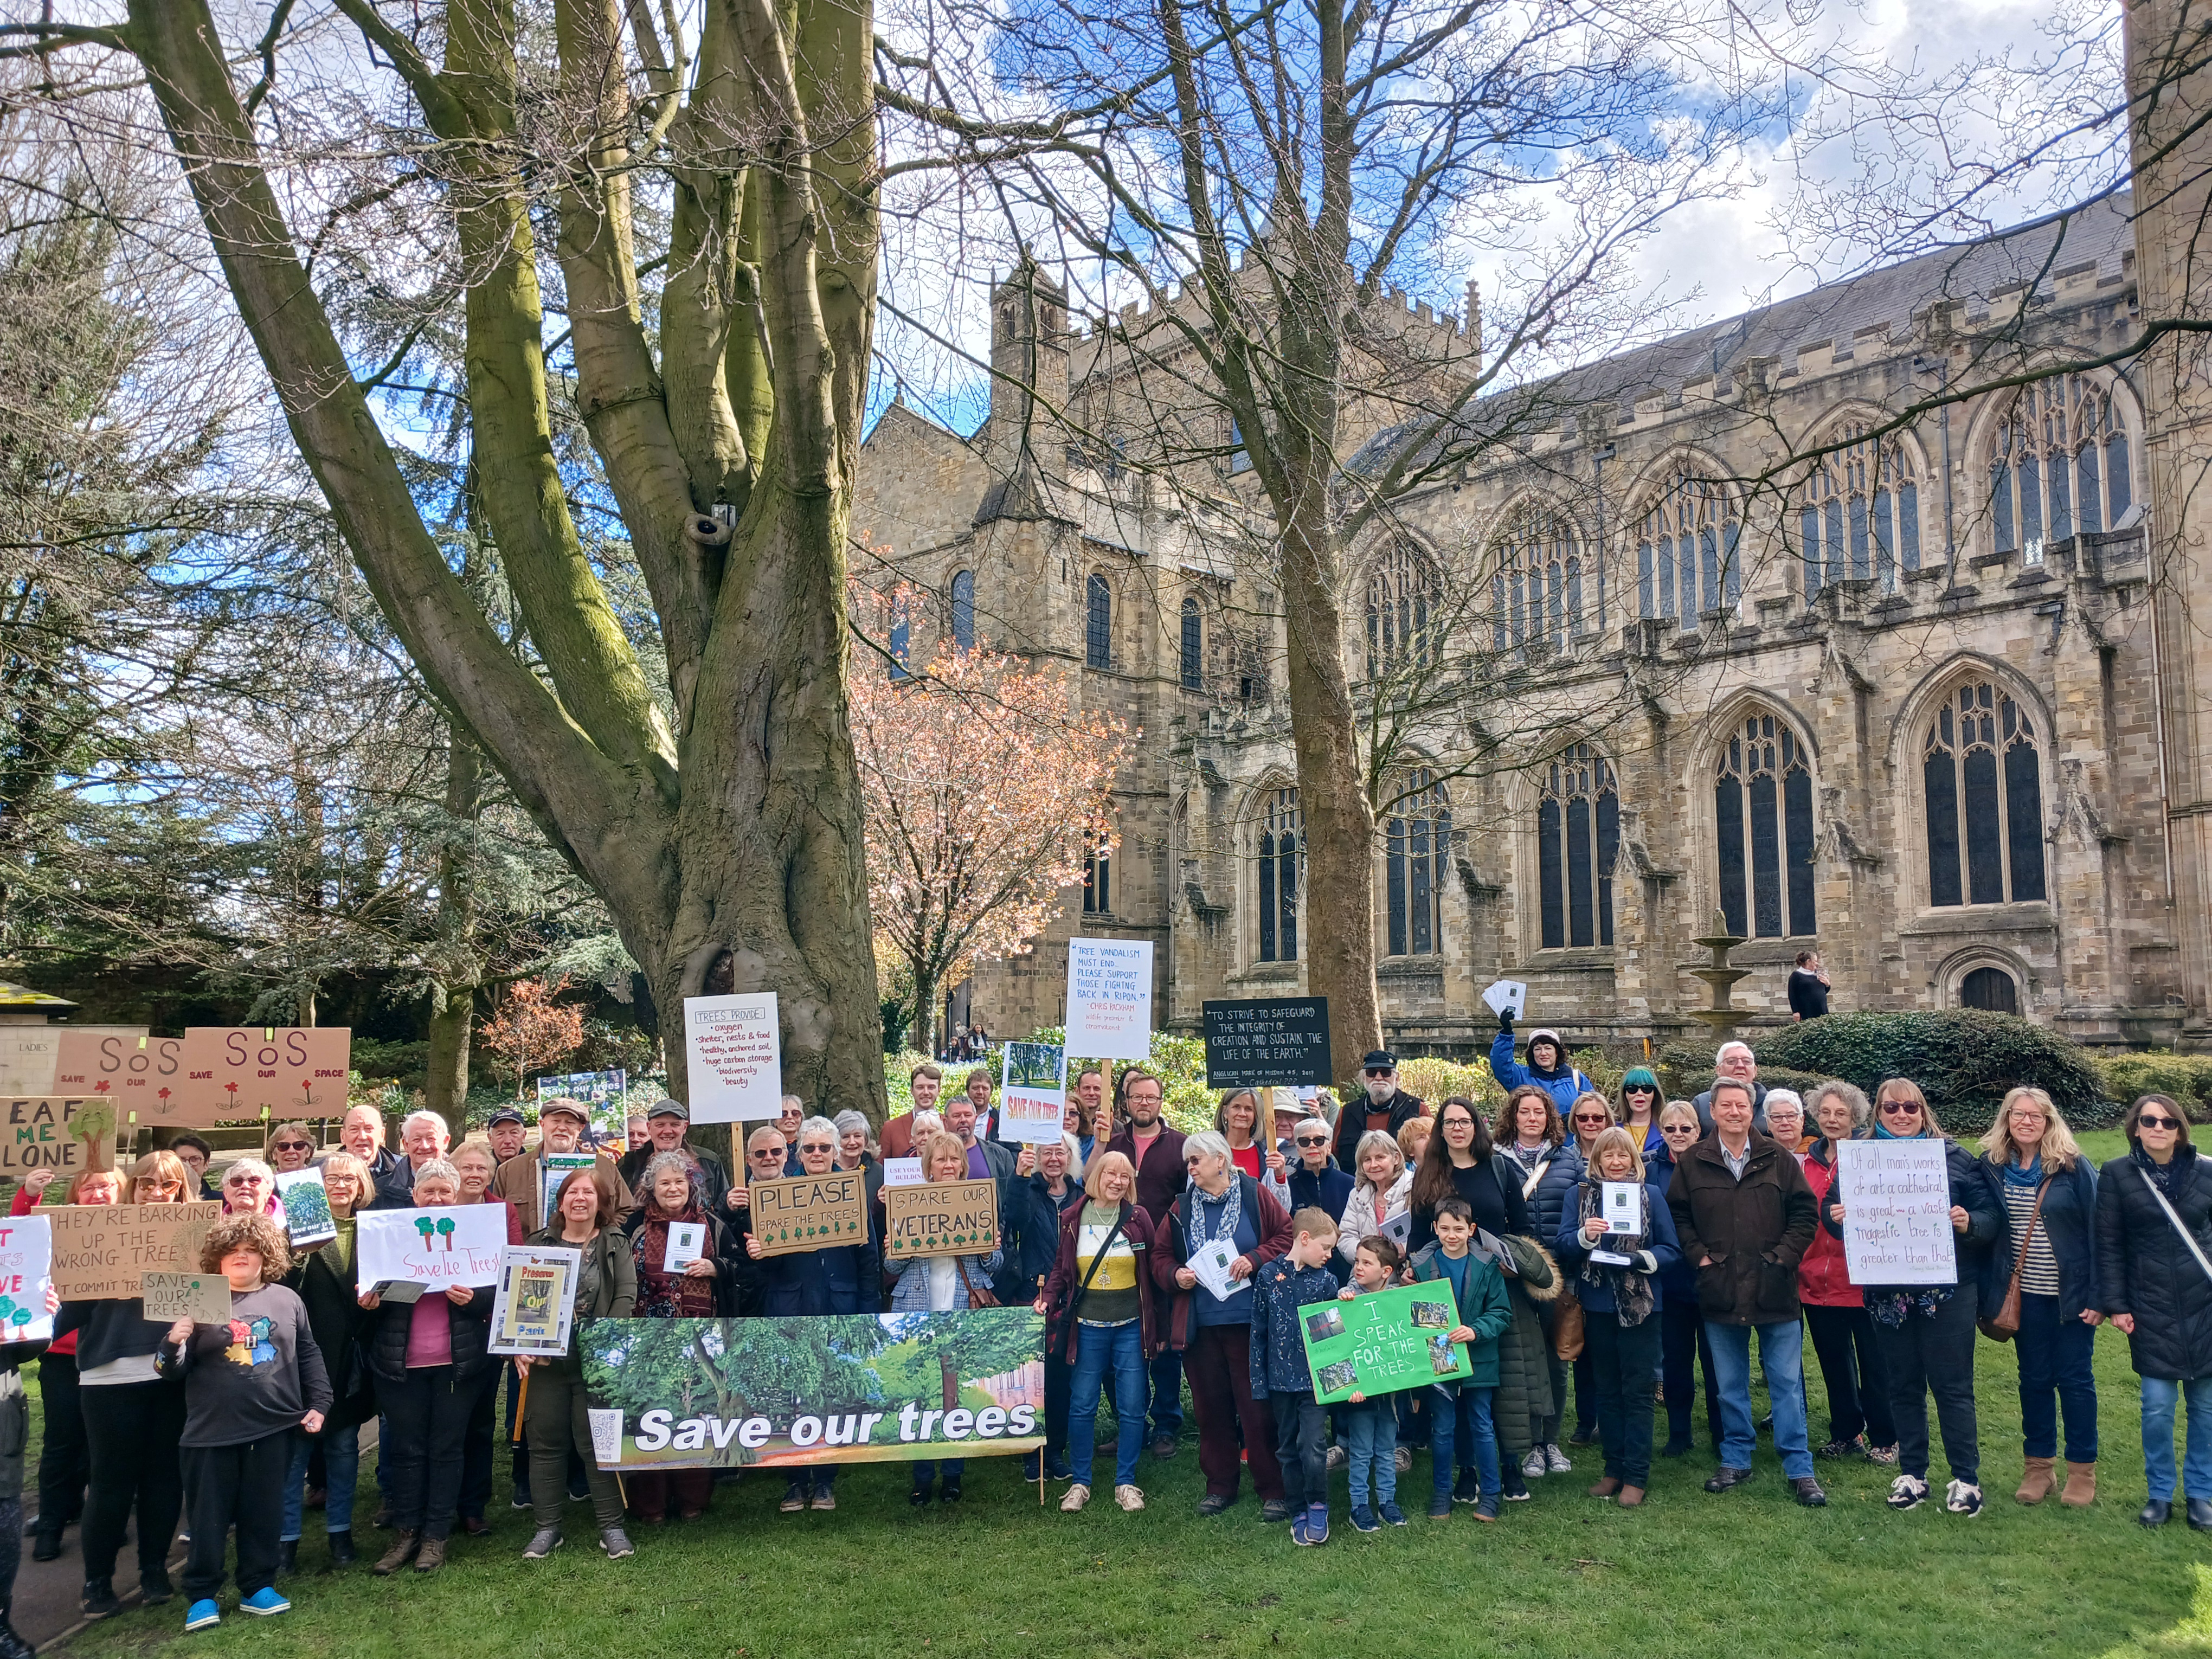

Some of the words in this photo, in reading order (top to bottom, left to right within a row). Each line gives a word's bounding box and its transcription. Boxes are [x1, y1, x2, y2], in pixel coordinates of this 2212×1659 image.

[1099, 948, 1140, 958] VANDALISM
[1078, 958, 1097, 966] MUST
[1077, 968, 1103, 978] PLEASE
[1107, 970, 1138, 979] SUPPORT
[1076, 979, 1099, 988] THOSE
[1077, 989, 1097, 999] BACK
[1102, 991, 1109, 999] IN
[1109, 1003, 1135, 1012] PACKHAM
[1227, 1009, 1254, 1020] STRIVE
[1258, 1009, 1269, 1019] TO
[1271, 1007, 1315, 1018] SAFEGUARD
[697, 1011, 726, 1022] TREES
[715, 1024, 743, 1034] oxygen
[1218, 1023, 1234, 1033] THE
[1237, 1021, 1274, 1033] INTEGRITY
[1276, 1021, 1285, 1031] OF
[726, 1032, 746, 1041] nests
[755, 1031, 770, 1039] food
[1212, 1036, 1249, 1046] CREATION
[1252, 1034, 1266, 1045] AND
[1269, 1033, 1303, 1045] SUSTAIN
[1307, 1032, 1322, 1044] THE
[20, 1043, 48, 1052] LADIES
[728, 1044, 756, 1052] anchored
[1223, 1049, 1239, 1060] LIFE
[1242, 1049, 1251, 1059] OF
[1255, 1048, 1270, 1059] THE
[705, 1057, 722, 1066] huge
[747, 1054, 773, 1063] storage
[189, 1070, 213, 1079] SAVE
[258, 1070, 276, 1078] OUR
[314, 1069, 344, 1077] SPACE
[718, 1065, 757, 1076] biodiversity
[1302, 1070, 1315, 1078] 2017
[61, 1075, 85, 1084] SAVE
[126, 1078, 146, 1086] OUR
[725, 1076, 748, 1089] beauty
[1249, 1078, 1282, 1086] Cathedral
[545, 1086, 570, 1095] Save
[573, 1085, 591, 1093] our
[593, 1082, 620, 1091] trees
[9, 1100, 83, 1124] EAF
[1007, 1095, 1027, 1120] SAVE
[1028, 1099, 1041, 1120] OUR
[1043, 1102, 1059, 1120] TREES
[17, 1123, 56, 1144] ME
[3, 1143, 78, 1167] LONE
[1850, 1148, 1862, 1170] Of
[1867, 1146, 1881, 1170] all
[1913, 1156, 1940, 1170] works
[1854, 1175, 1865, 1196] of
[1870, 1173, 1885, 1195] art
[1887, 1186, 1895, 1195] a
[1898, 1173, 1945, 1193] cathedral
[760, 1179, 856, 1213] PLEASE
[896, 1191, 953, 1209] SPARE
[963, 1187, 989, 1206] OUR
[1856, 1205, 1865, 1218] is
[1869, 1197, 1896, 1223] great
[1908, 1206, 1917, 1216] a
[1921, 1198, 1945, 1215] vast
[50, 1208, 132, 1230] HEY'RE
[139, 1205, 217, 1224] BARKING
[759, 1217, 790, 1231] SPARE
[793, 1213, 815, 1225] THE
[819, 1208, 859, 1221] TREES
[892, 1210, 992, 1237] VETERANS
[290, 1225, 306, 1234] Save
[307, 1222, 320, 1232] our
[1855, 1221, 1900, 1247] magestic
[1908, 1217, 1930, 1237] tree
[1933, 1223, 1942, 1238] is
[82, 1233, 105, 1249] UP
[117, 1230, 157, 1246] THE
[55, 1249, 120, 1269] WRONG
[131, 1245, 180, 1265] TREE
[1860, 1245, 1899, 1270] greater
[1904, 1245, 1928, 1264] than
[1932, 1244, 1952, 1264] that
[403, 1253, 440, 1278] Save
[74, 1279, 118, 1294] COMMIT
[147, 1274, 189, 1289] SAVE
[155, 1290, 186, 1304] OUR
[524, 1295, 548, 1308] Our
[146, 1303, 190, 1316] TREES
[1363, 1301, 1382, 1322] I
[517, 1324, 546, 1336] Park
[1353, 1319, 1407, 1348] SPEAK
[245, 1335, 258, 1349] H
[1352, 1345, 1384, 1367] FOR
[1387, 1337, 1417, 1357] THE
[1366, 1356, 1416, 1380] TREES
[634, 1408, 771, 1452] Save
[789, 1411, 883, 1447] our
[897, 1400, 1037, 1442] trees
